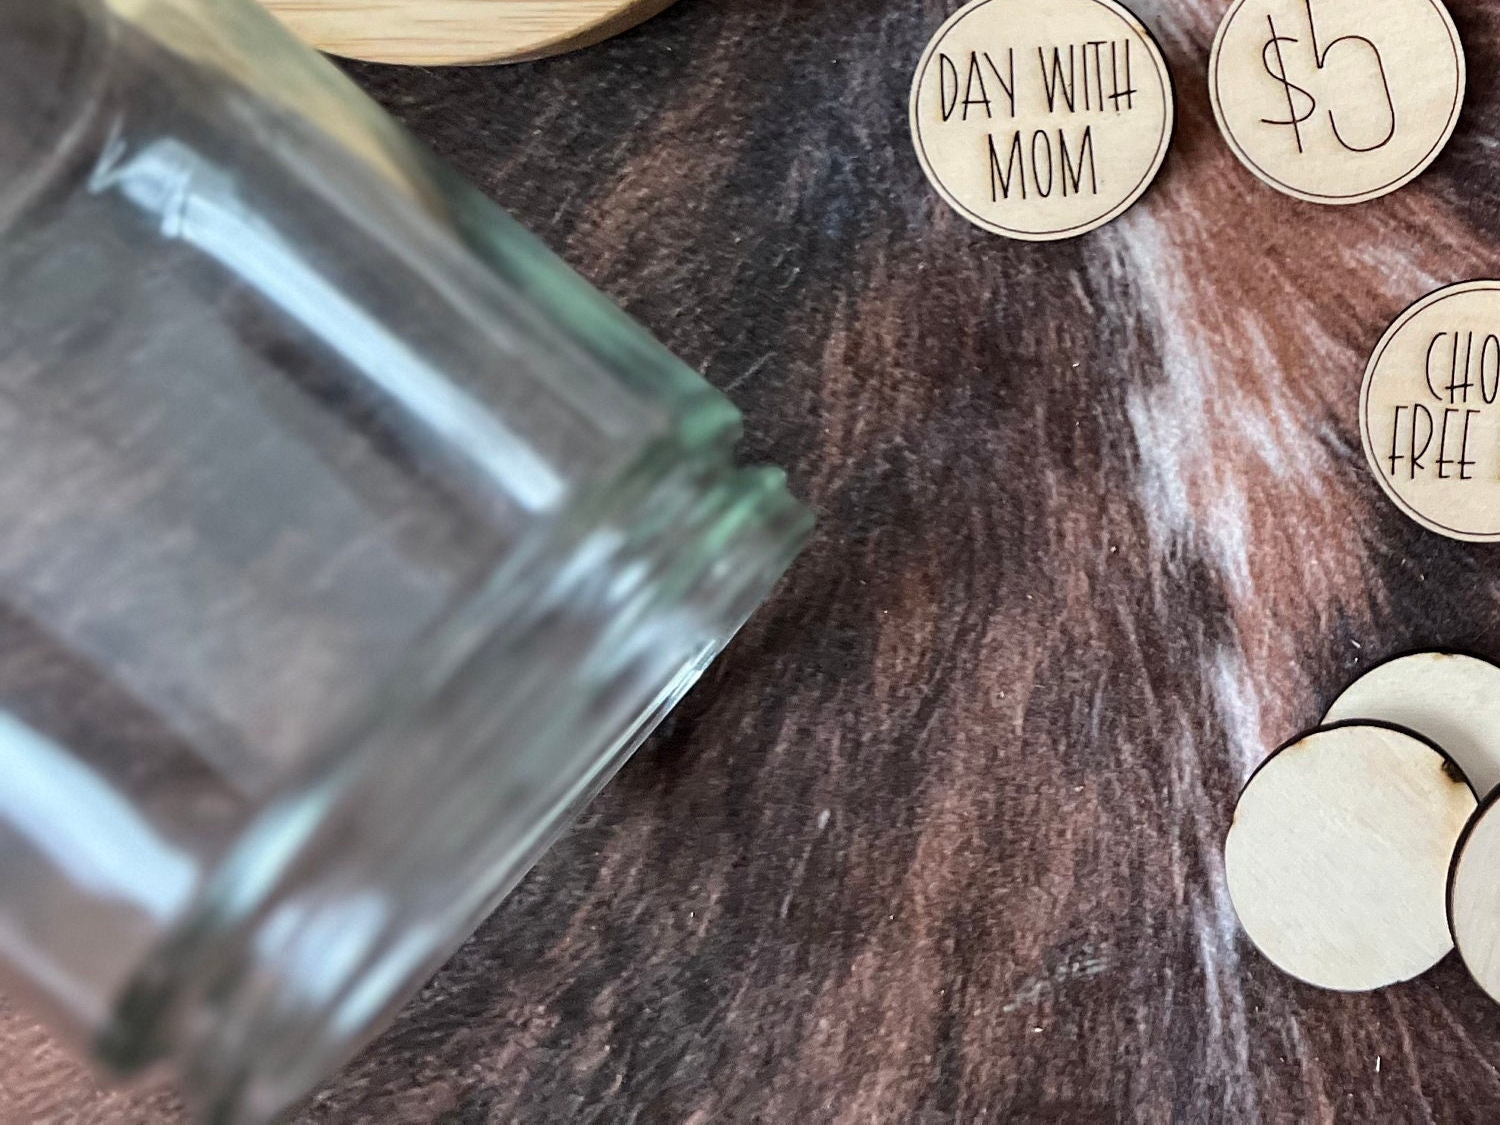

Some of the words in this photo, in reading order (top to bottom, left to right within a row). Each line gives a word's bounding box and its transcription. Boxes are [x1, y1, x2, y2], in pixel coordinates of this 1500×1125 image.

[938, 47, 1015, 123] DAY
[1037, 38, 1138, 114] WITH
[987, 124, 1098, 203] MOM
[1387, 402, 1481, 481] FREE
